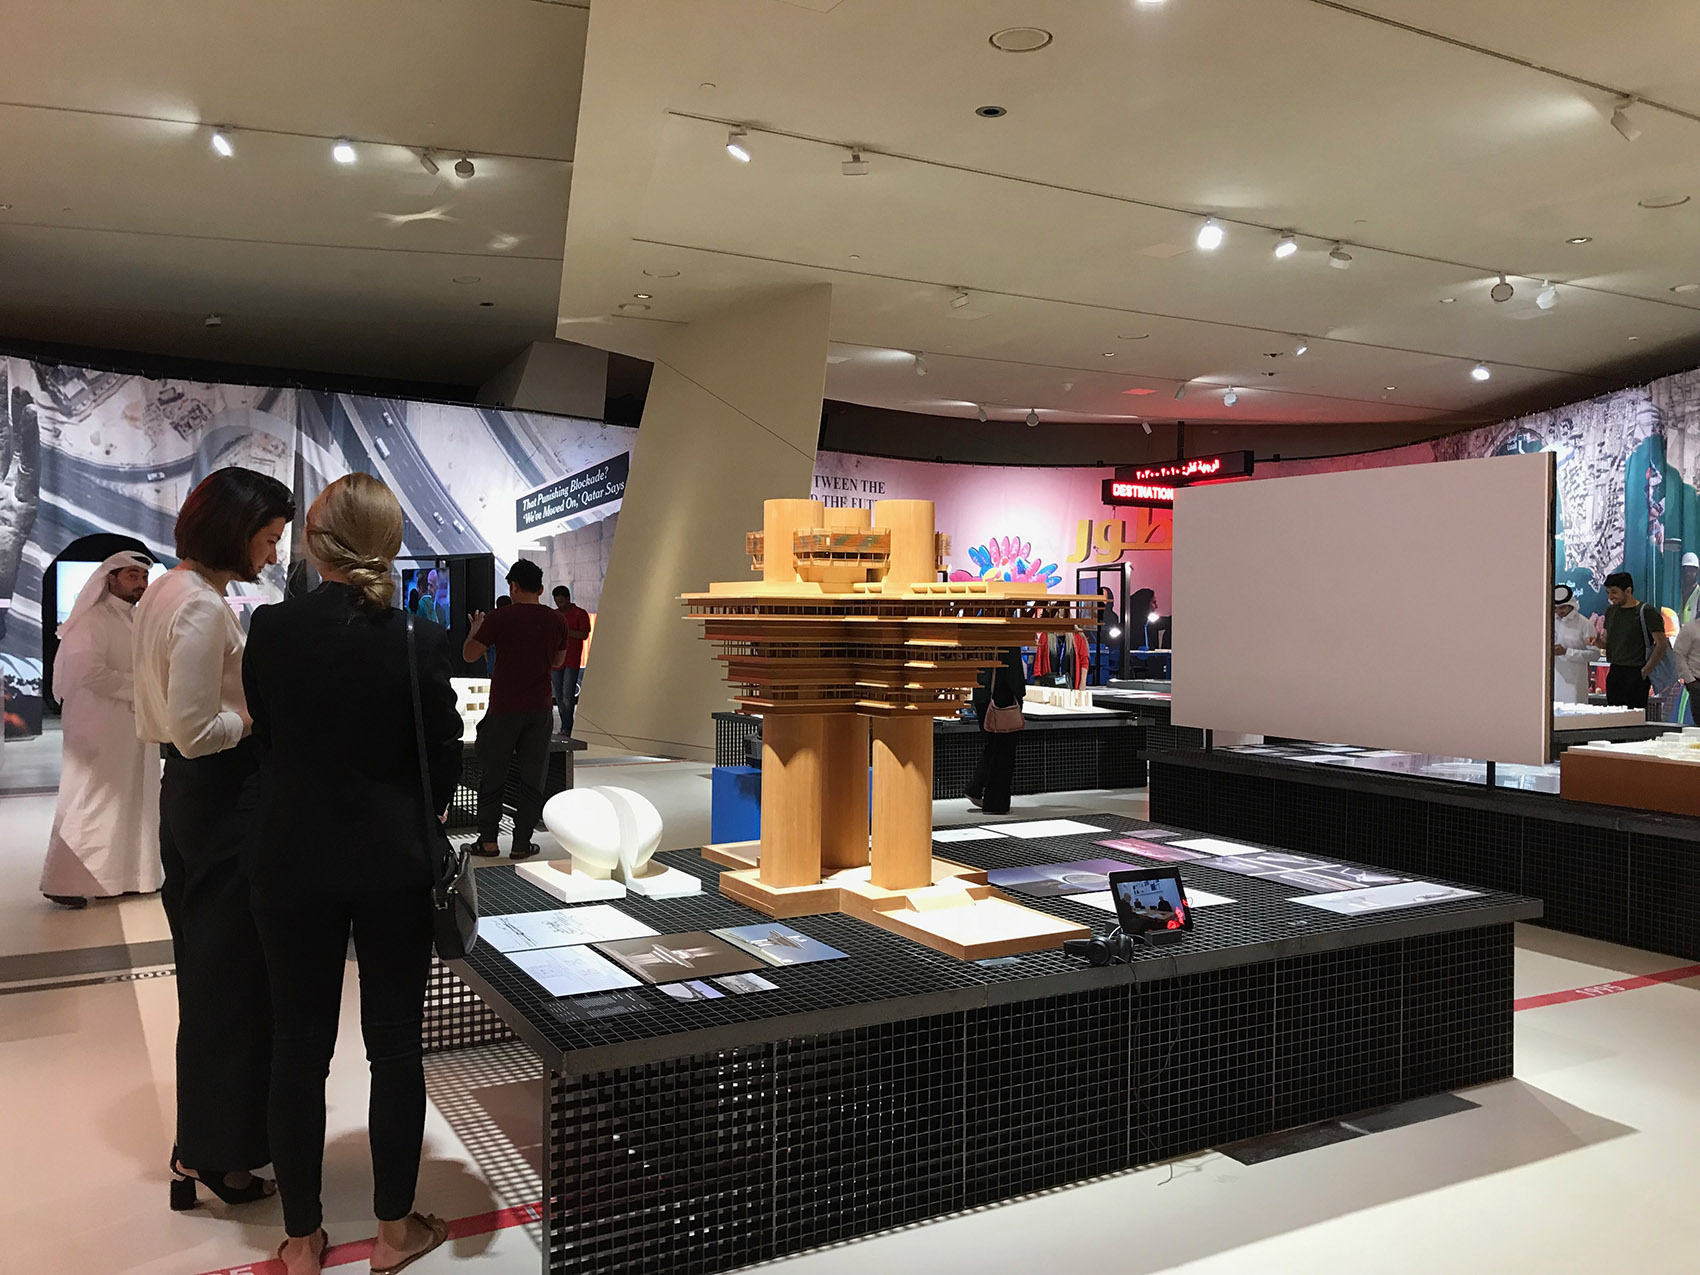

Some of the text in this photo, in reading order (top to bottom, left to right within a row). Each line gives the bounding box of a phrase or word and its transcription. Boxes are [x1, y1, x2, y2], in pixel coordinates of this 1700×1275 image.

[523, 466, 609, 511] That Punishing Blockade?
[861, 480, 886, 494] THE
[1112, 483, 1174, 500] DESTINATION
[542, 501, 565, 518] Moved
[581, 488, 605, 506] Qatar
[605, 481, 625, 497] Says
[822, 495, 848, 508] THE
[851, 497, 878, 510] FUT
[1575, 983, 1626, 997] 1995
